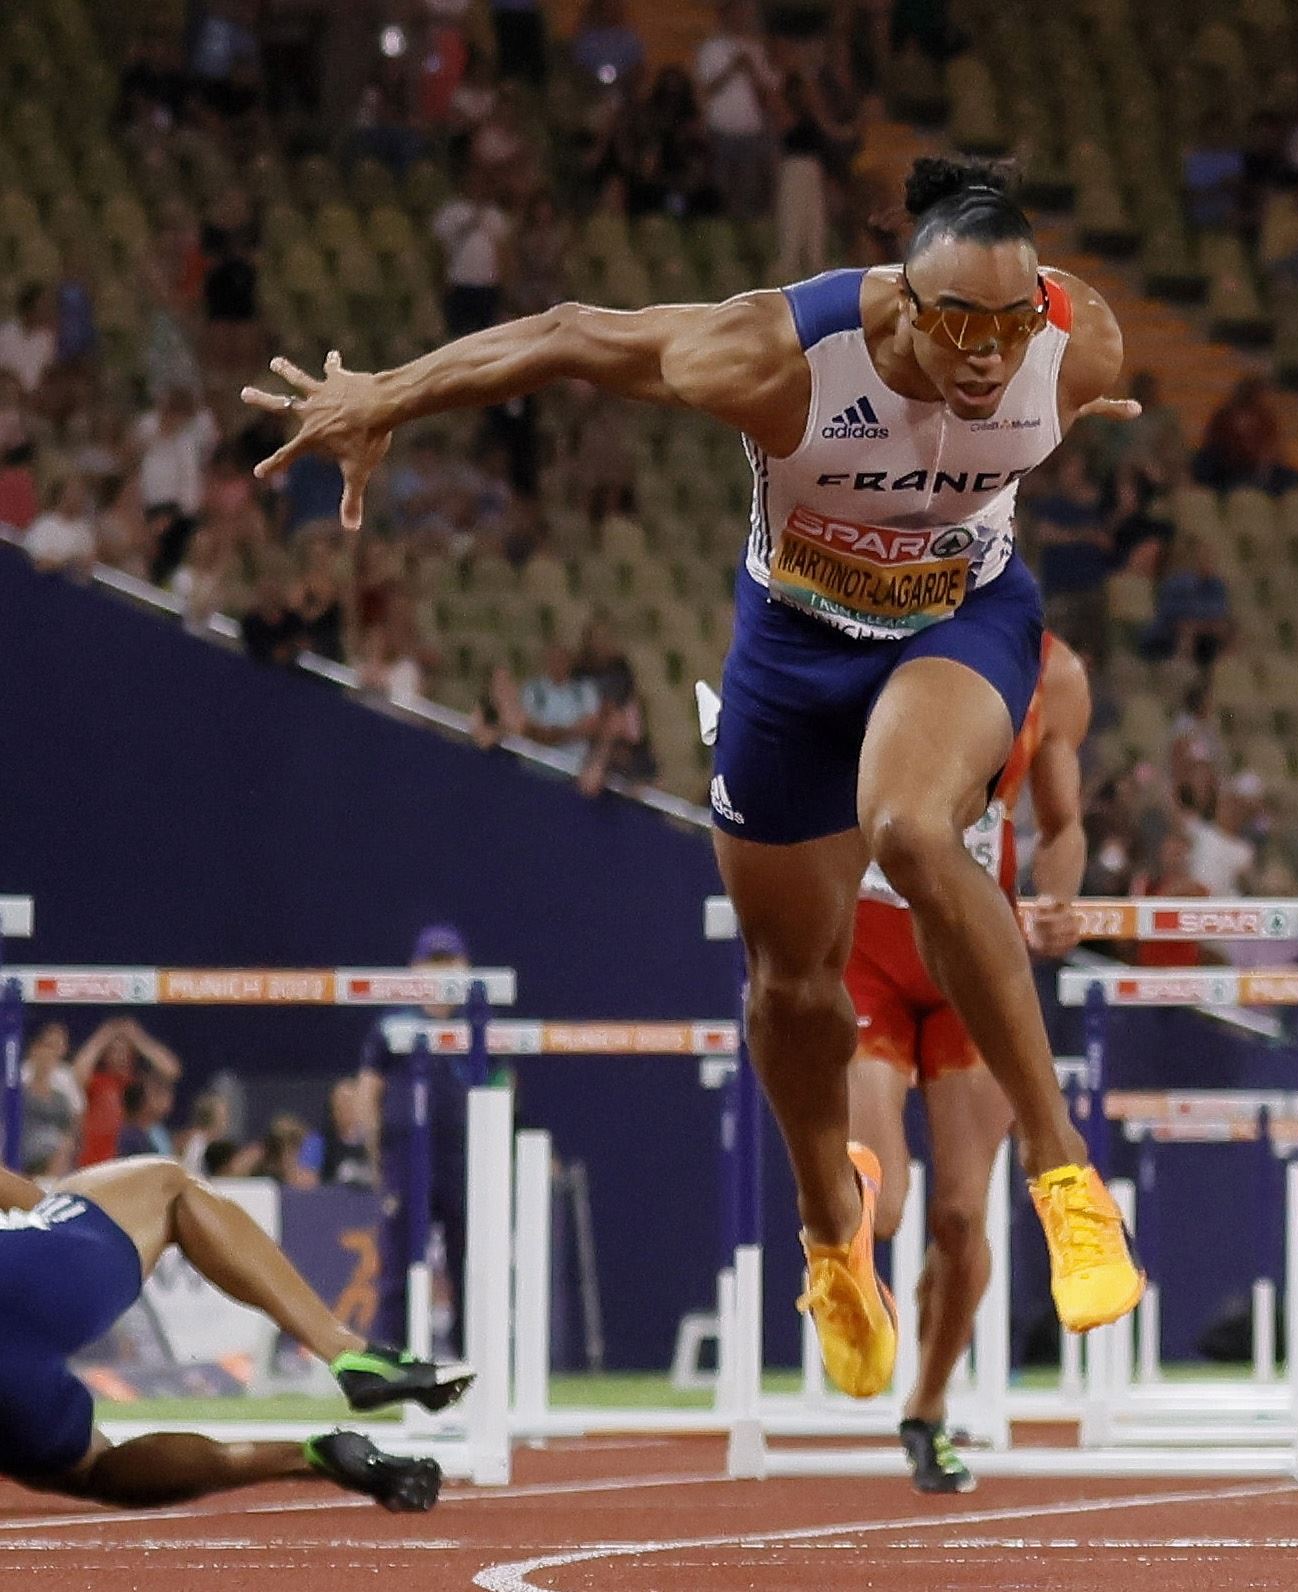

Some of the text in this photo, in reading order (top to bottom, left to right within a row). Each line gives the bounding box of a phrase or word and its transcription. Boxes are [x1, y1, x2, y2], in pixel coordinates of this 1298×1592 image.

[822, 425, 889, 440] adidas
[791, 512, 926, 560] SPAR
[777, 538, 962, 608] MARTINOT-LAGARDE
[1180, 911, 1257, 934] SPAR
